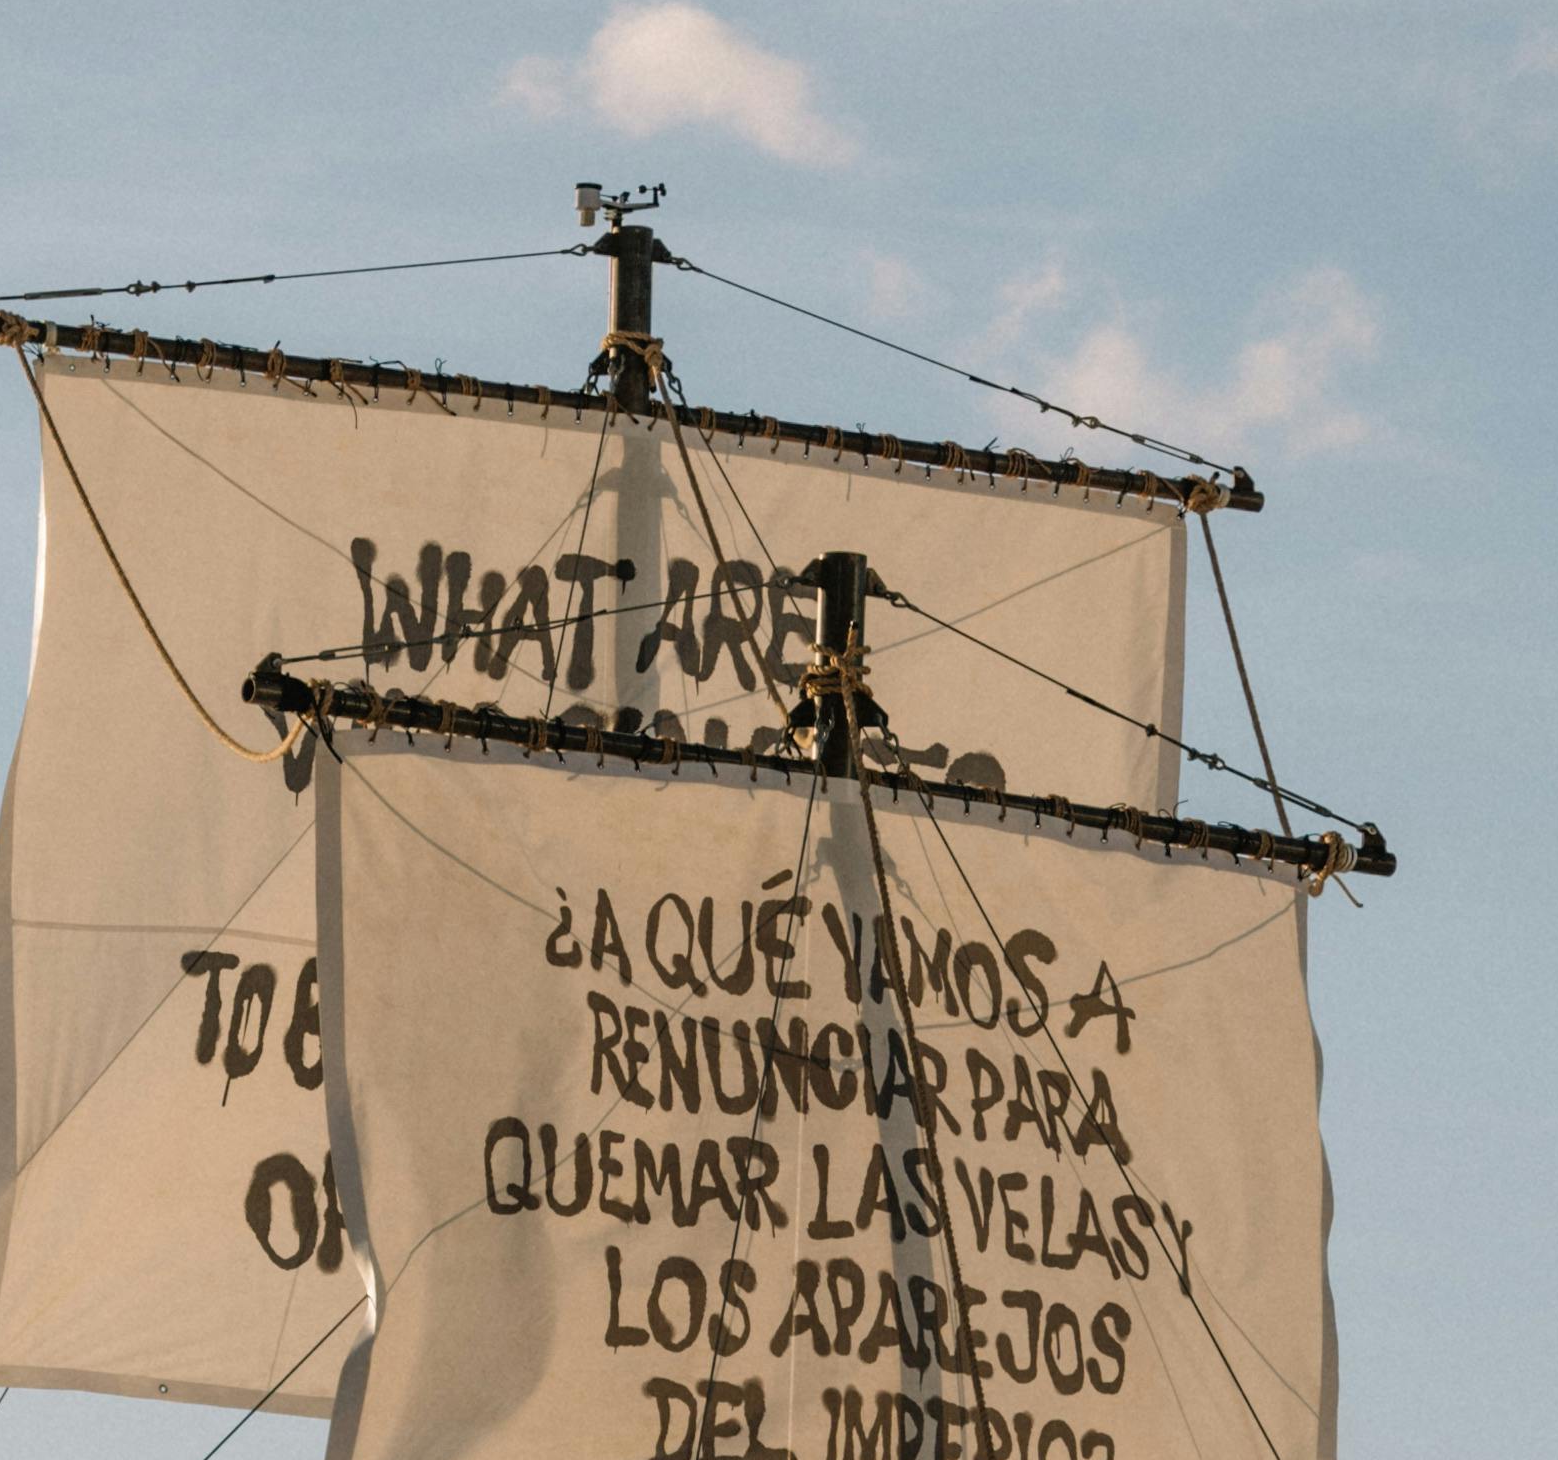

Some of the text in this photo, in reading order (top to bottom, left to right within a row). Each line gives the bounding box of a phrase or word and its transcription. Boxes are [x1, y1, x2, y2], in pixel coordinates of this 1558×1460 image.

[351, 537, 818, 692] WHAT ARE
[545, 868, 1136, 1053] ¿A QUÉ VAMOS A
[588, 991, 1134, 1165] RENUNCIAR PARA
[484, 1117, 1195, 1297] QUEMAR LAS VELAS Y
[605, 1246, 1132, 1395] LOS APAREJOS
